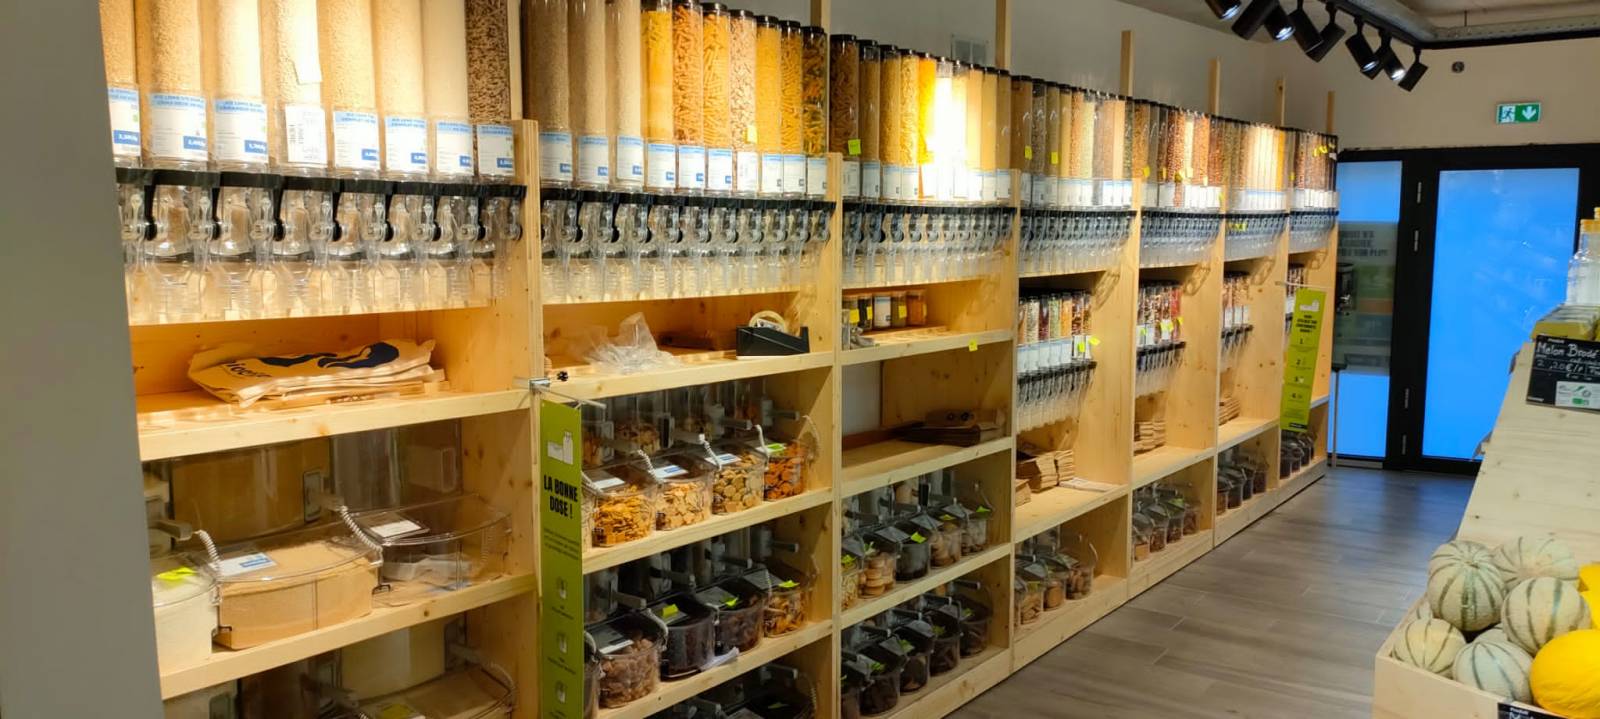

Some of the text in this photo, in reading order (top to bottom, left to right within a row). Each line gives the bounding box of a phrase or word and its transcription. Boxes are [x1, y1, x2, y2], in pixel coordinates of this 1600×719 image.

[1537, 341, 1564, 356] Melon
[544, 474, 578, 502] LA BONNE
[549, 495, 568, 517] DOSE
